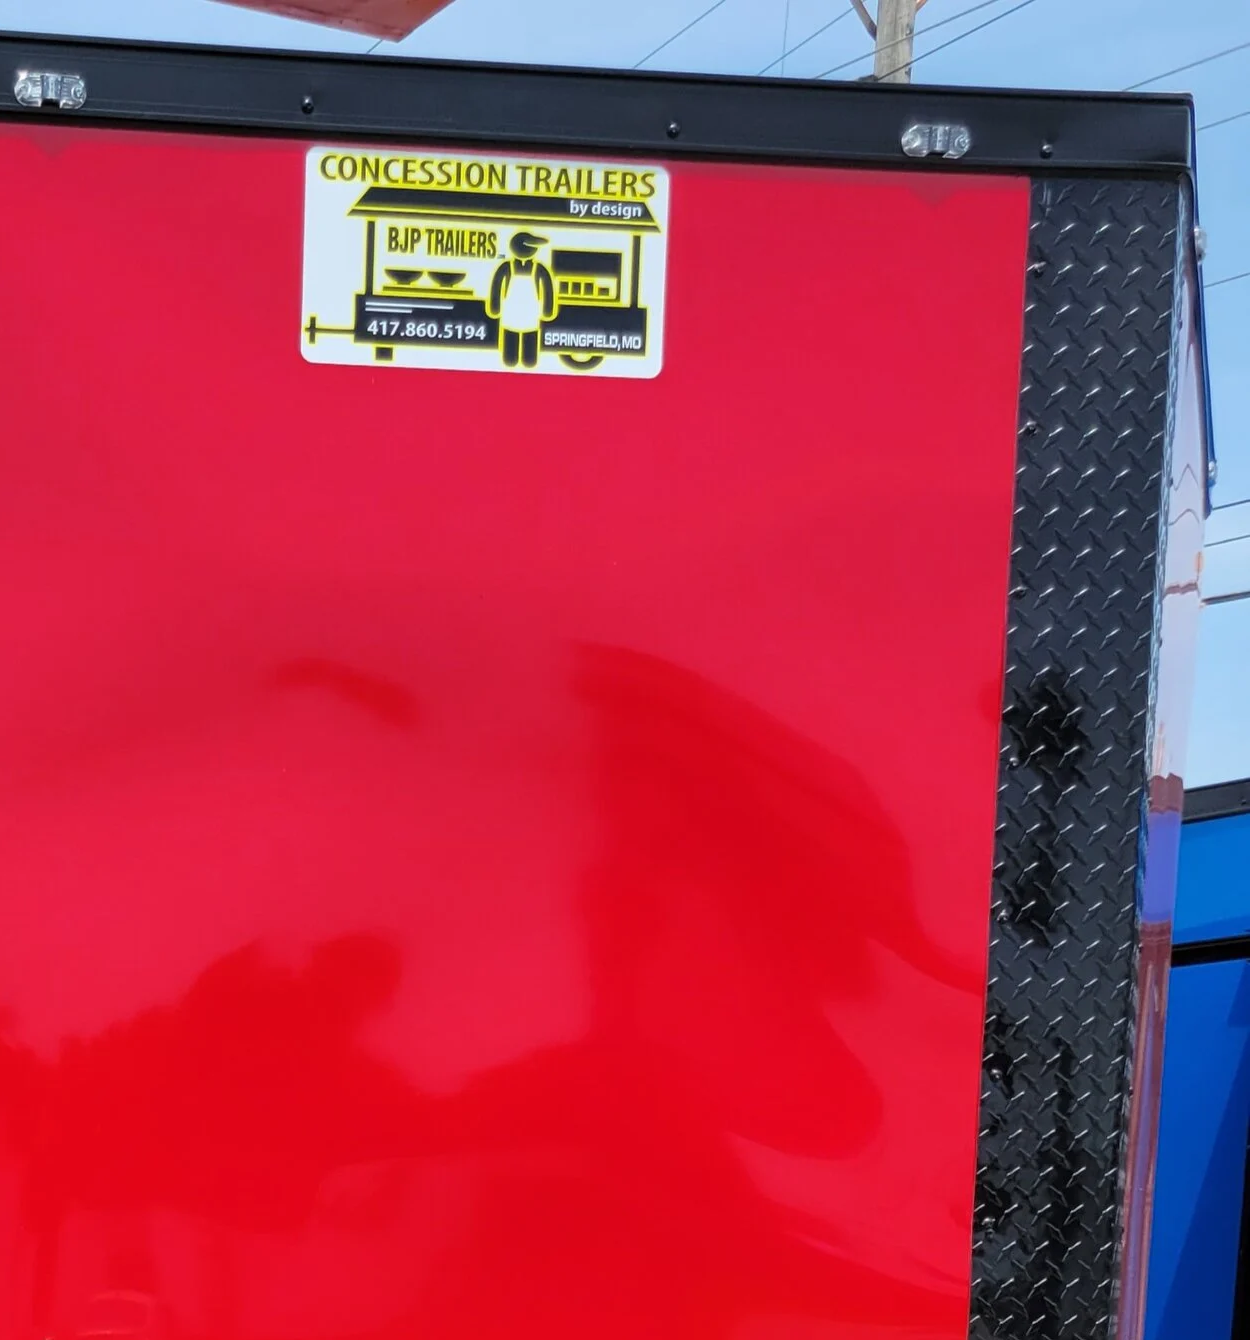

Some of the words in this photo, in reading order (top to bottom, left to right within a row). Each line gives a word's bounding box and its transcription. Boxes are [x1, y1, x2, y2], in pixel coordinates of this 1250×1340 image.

[319, 153, 506, 190] CONCESSION
[515, 165, 656, 198] TRAILERS
[569, 199, 589, 217] by
[591, 202, 642, 218] design
[387, 227, 421, 254] BJP
[425, 228, 497, 259] TRAILERS
[366, 319, 487, 341] 417.860.5194
